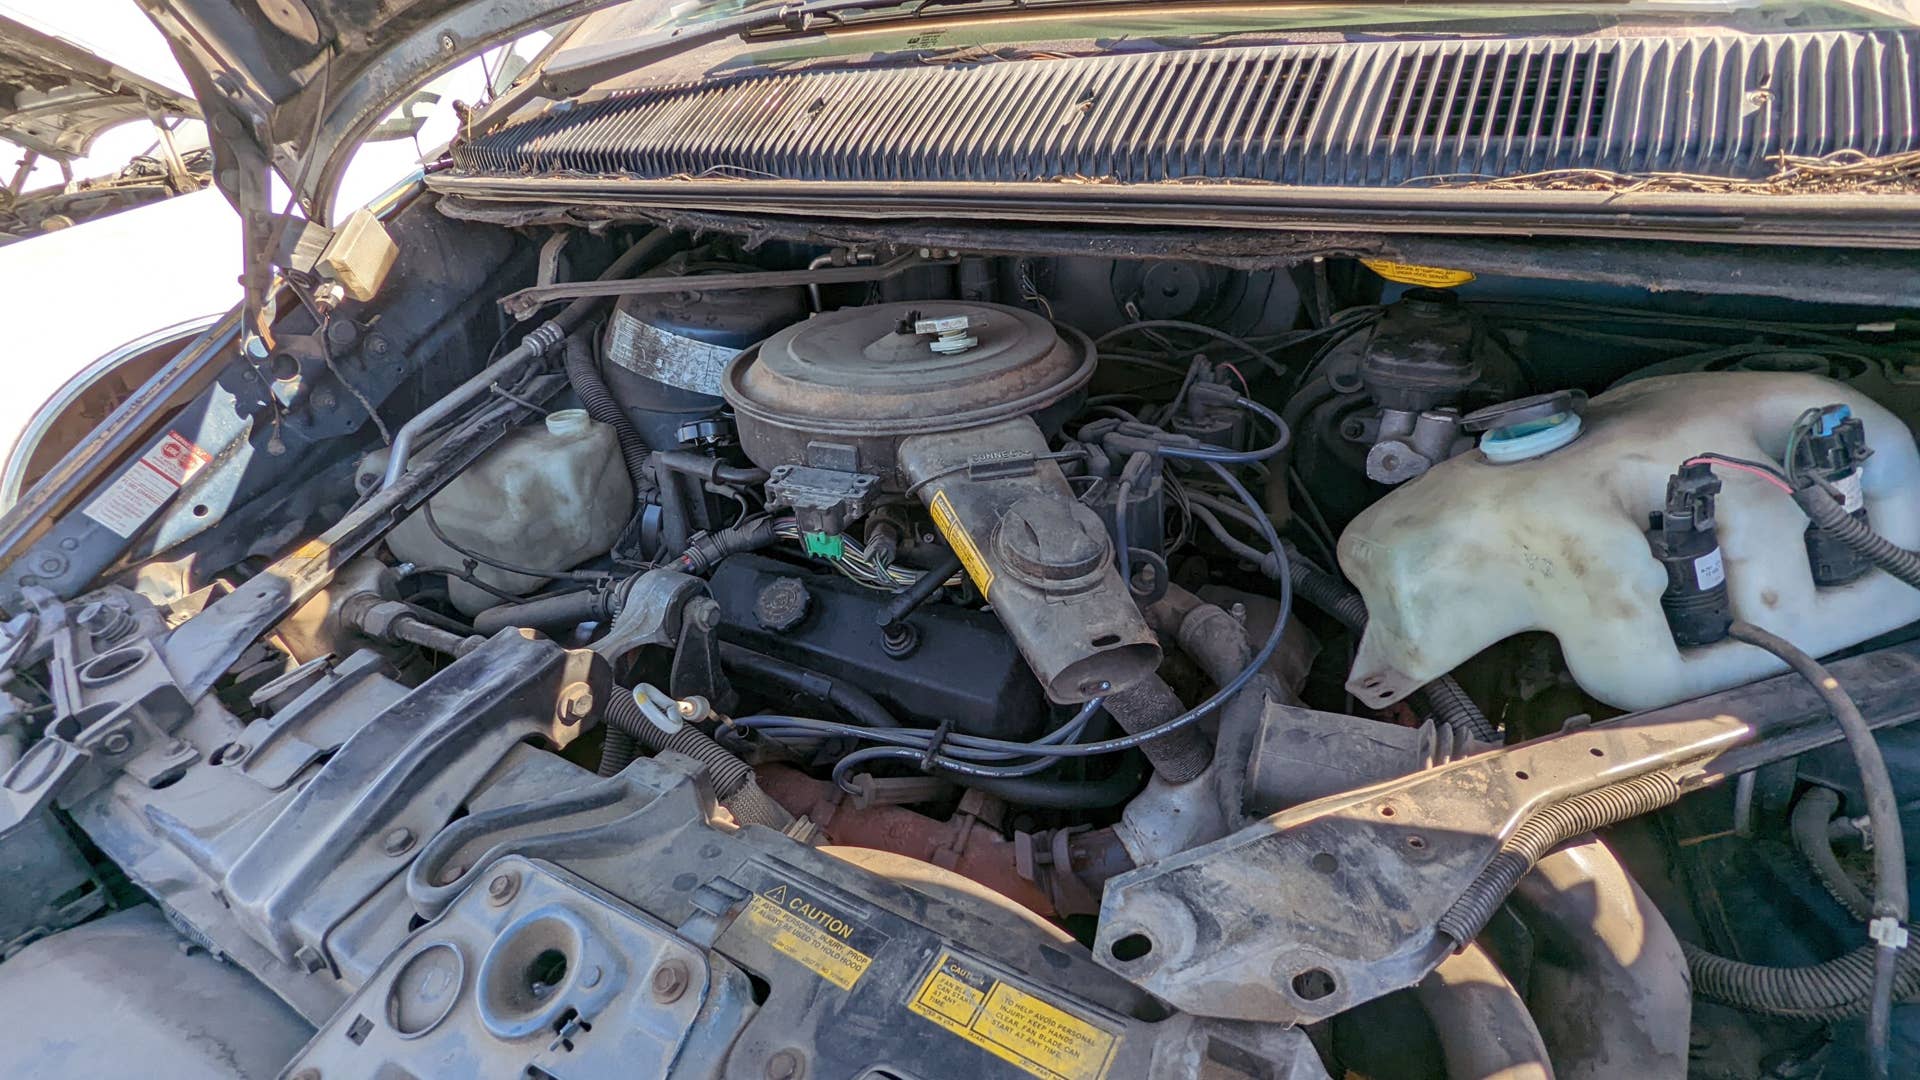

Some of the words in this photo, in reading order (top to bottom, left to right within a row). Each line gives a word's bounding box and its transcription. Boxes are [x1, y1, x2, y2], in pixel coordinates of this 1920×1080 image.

[789, 898, 855, 939] CAUTION
[791, 927, 812, 943] USED
[810, 938, 822, 949] TO
[819, 943, 841, 960] HOLD
[839, 955, 862, 972] HOOD
[846, 948, 868, 965] PROP
[935, 982, 951, 995] CAN
[941, 993, 957, 1005] ANY
[990, 1018, 1014, 1034] START
[1014, 1030, 1026, 1040] AT
[1024, 1035, 1042, 1048] ANY
[1003, 997, 1014, 1007] TO
[1013, 1002, 1034, 1016] HELP
[1033, 1011, 1057, 1028] AVOID
[1056, 1022, 1097, 1047] PERSONAL
[1026, 1018, 1047, 1032] KEEP
[1047, 1027, 1074, 1045] HANDS
[1020, 1024, 1037, 1036] FAN
[1037, 1032, 1062, 1049] BLADE
[1062, 1044, 1081, 1059] CAN
